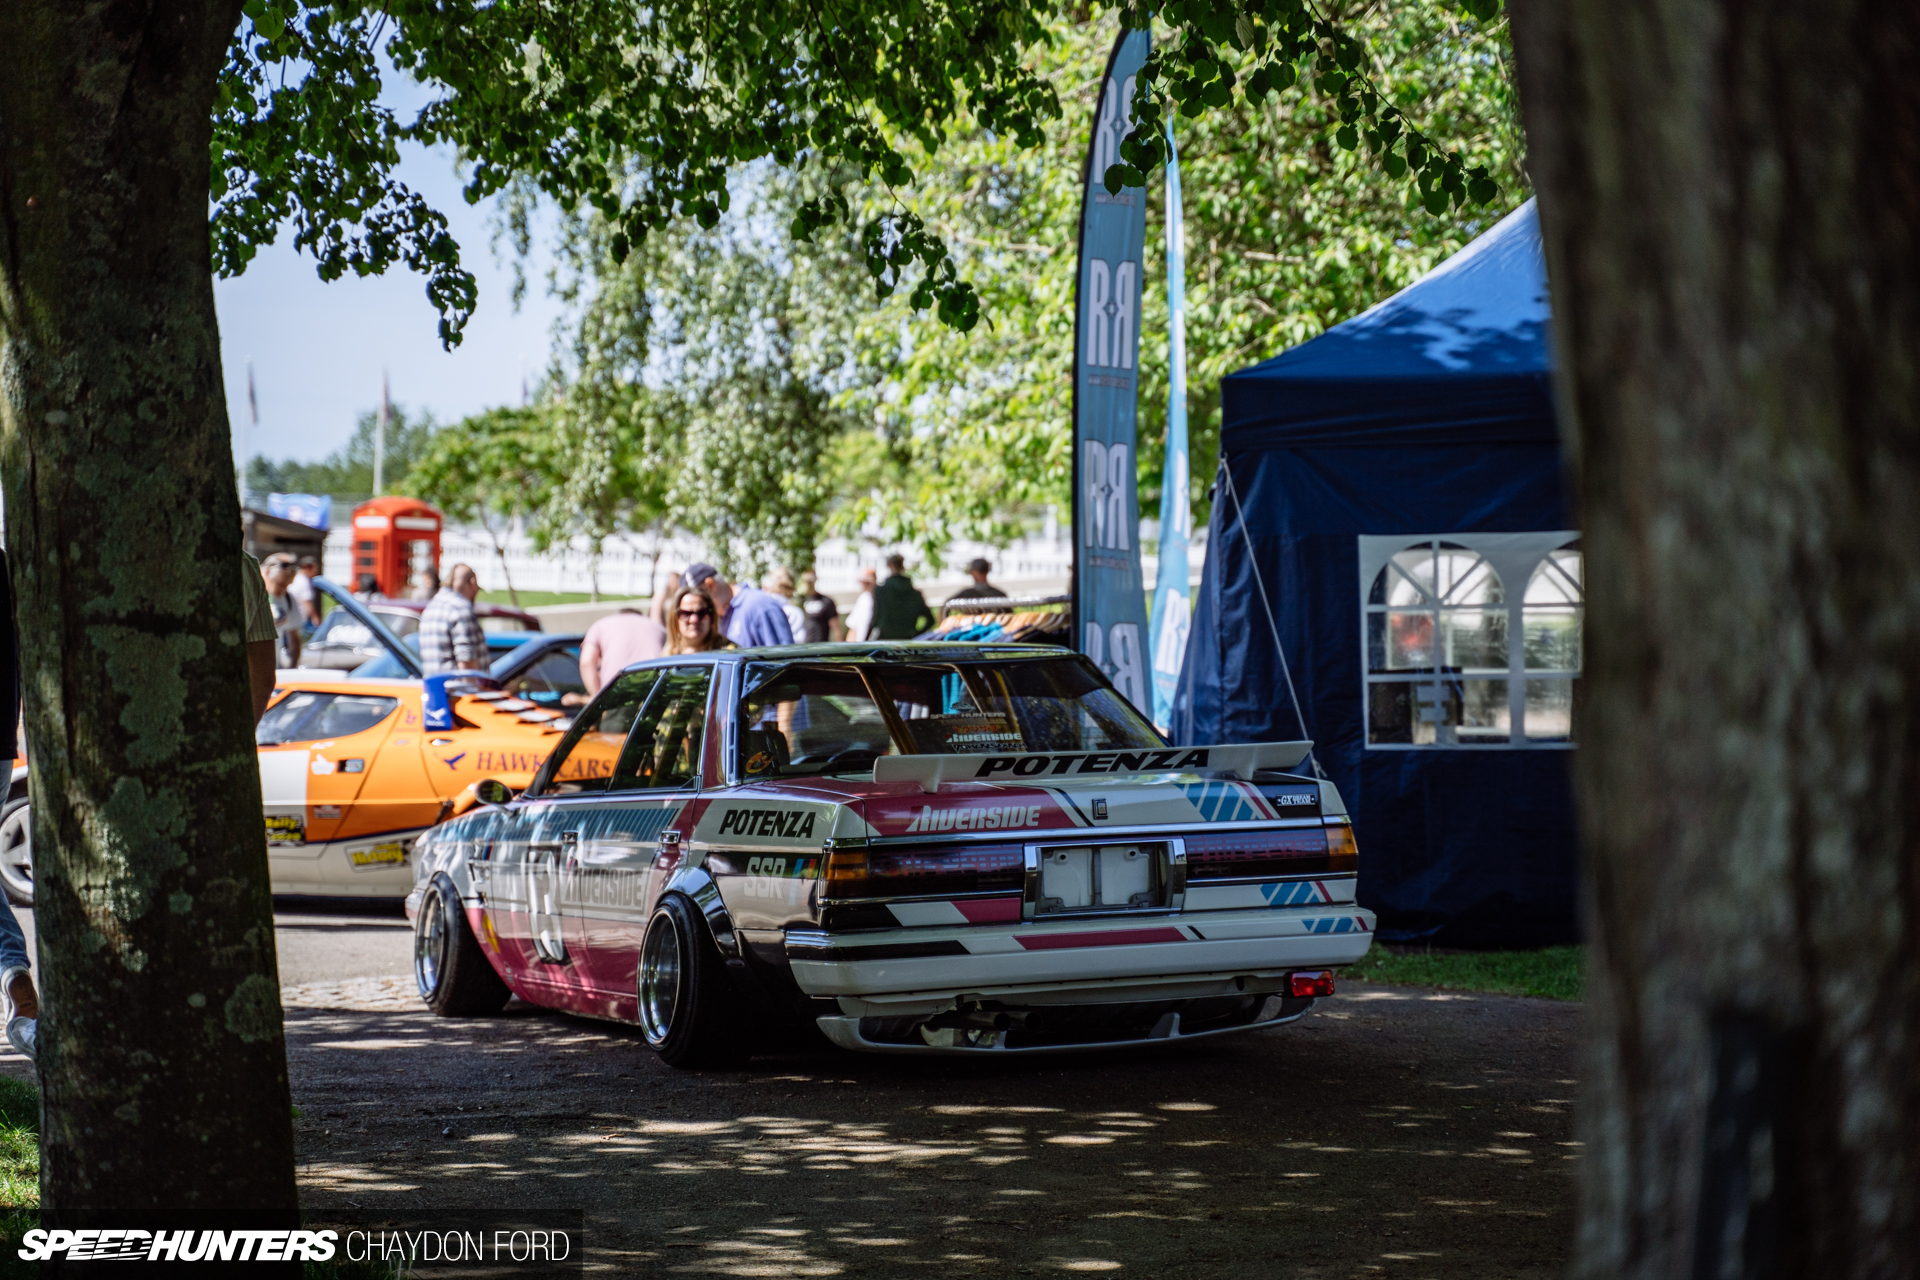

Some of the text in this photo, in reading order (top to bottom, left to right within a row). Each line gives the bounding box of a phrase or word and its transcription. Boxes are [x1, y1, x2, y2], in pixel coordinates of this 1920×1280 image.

[945, 733, 1022, 743] RIVERSIDE
[477, 751, 612, 780] HAWK CARS
[974, 749, 1210, 777] POTENZA
[718, 809, 816, 838] POTENZA
[905, 805, 1042, 833] RIVERSIDE
[743, 856, 786, 898] SSR
